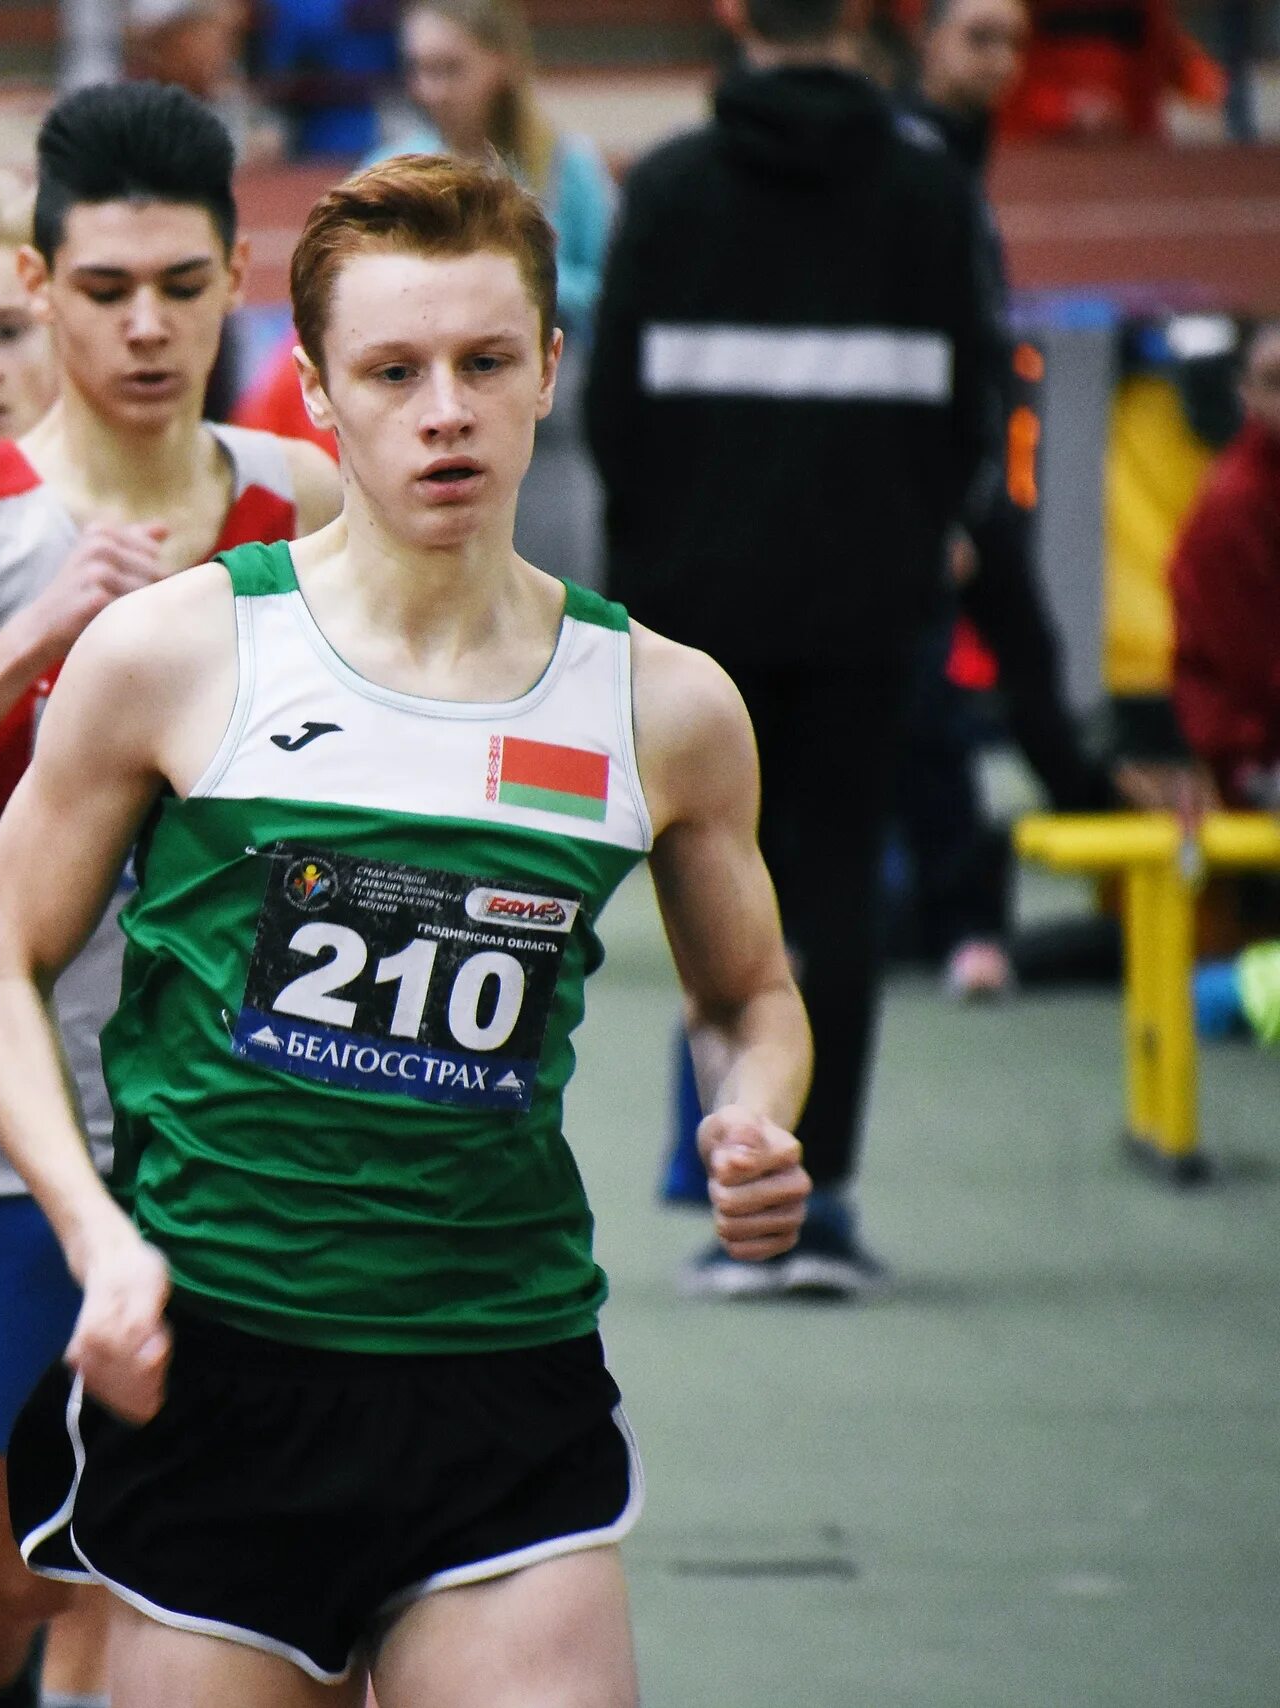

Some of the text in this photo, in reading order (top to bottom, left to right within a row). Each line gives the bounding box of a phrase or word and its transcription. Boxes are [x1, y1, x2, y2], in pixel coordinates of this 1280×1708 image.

[356, 865, 386, 878] СРЕДИ
[361, 879, 402, 892] ДЕВУШЕК
[376, 891, 414, 904] ФЕВРАЛЯ
[357, 899, 398, 913] МОГИЛЕВ
[417, 922, 558, 952] ГРОДНЕНСКАЯ ОБЛАСТЬ
[272, 921, 525, 1051] 210
[286, 1031, 489, 1091] БЕЛГОССТРАХ
